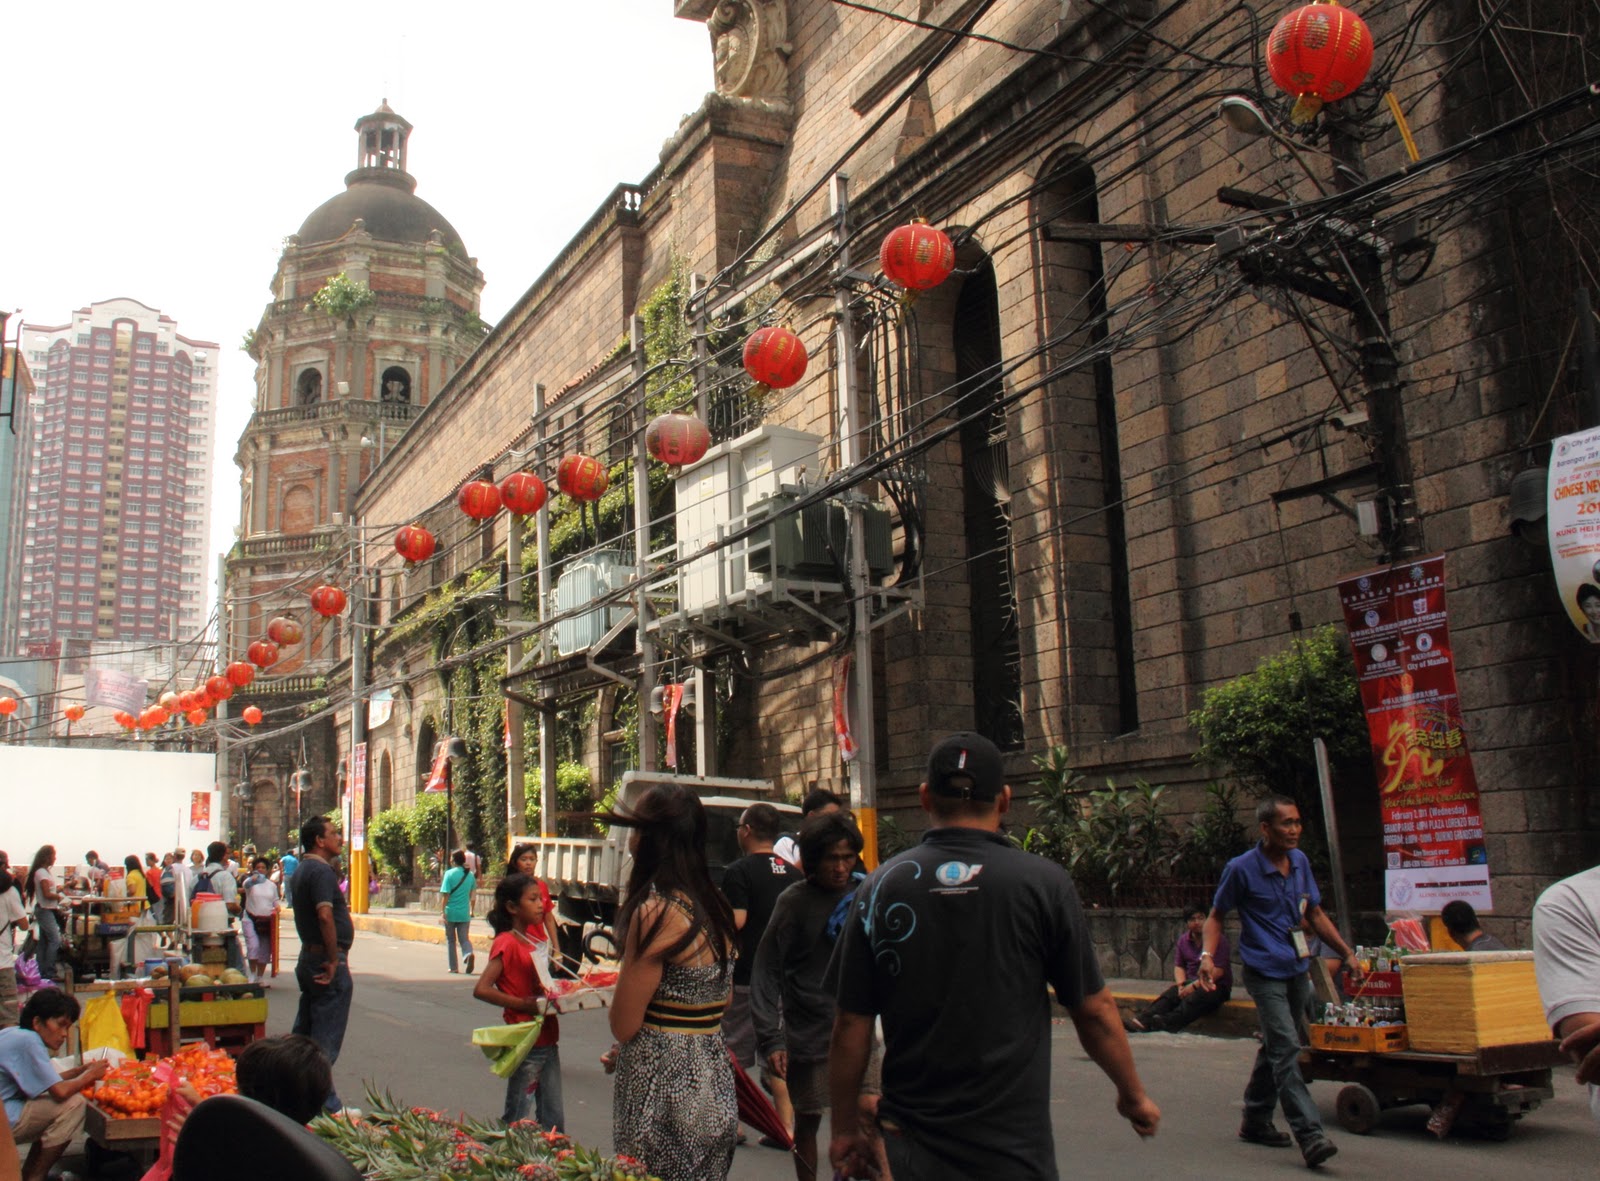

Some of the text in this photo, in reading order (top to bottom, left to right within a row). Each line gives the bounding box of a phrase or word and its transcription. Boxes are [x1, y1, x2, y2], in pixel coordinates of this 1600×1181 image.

[1554, 481, 1584, 501] CHINESE
[1556, 527, 1577, 537] KUNG
[1579, 525, 1594, 533] HEI
[1407, 663, 1418, 671] City
[1427, 657, 1449, 667] Manila
[1391, 811, 1413, 820] February
[1429, 804, 1468, 818] (Wednesday)
[1429, 819, 1445, 830] PLAZA
[1446, 817, 1467, 828] LORENZO
[1467, 816, 1480, 826] RUIZ
